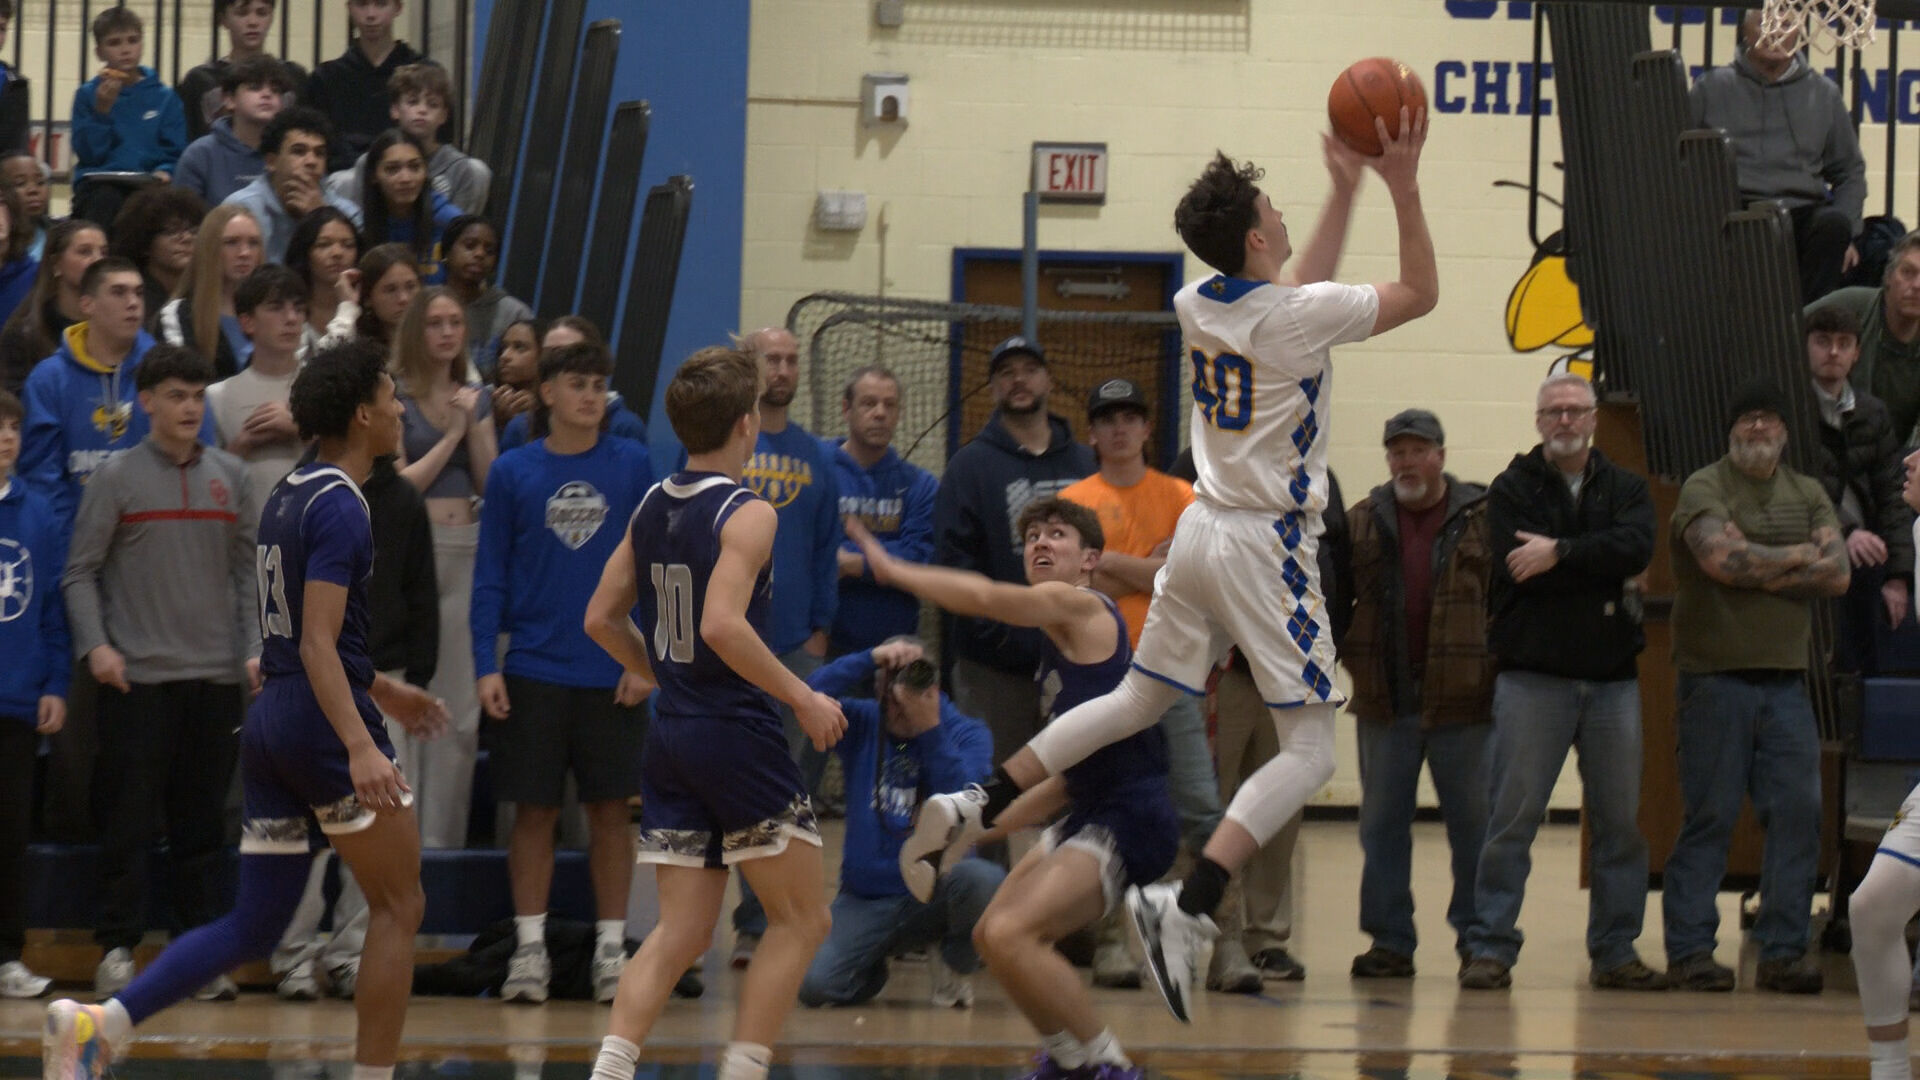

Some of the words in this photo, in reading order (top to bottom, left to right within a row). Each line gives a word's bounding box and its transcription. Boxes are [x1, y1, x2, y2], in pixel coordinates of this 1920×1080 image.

[1048, 152, 1100, 191] EXIT
[1190, 345, 1256, 432] 40
[256, 544, 293, 640] 13
[650, 562, 695, 664] 10
